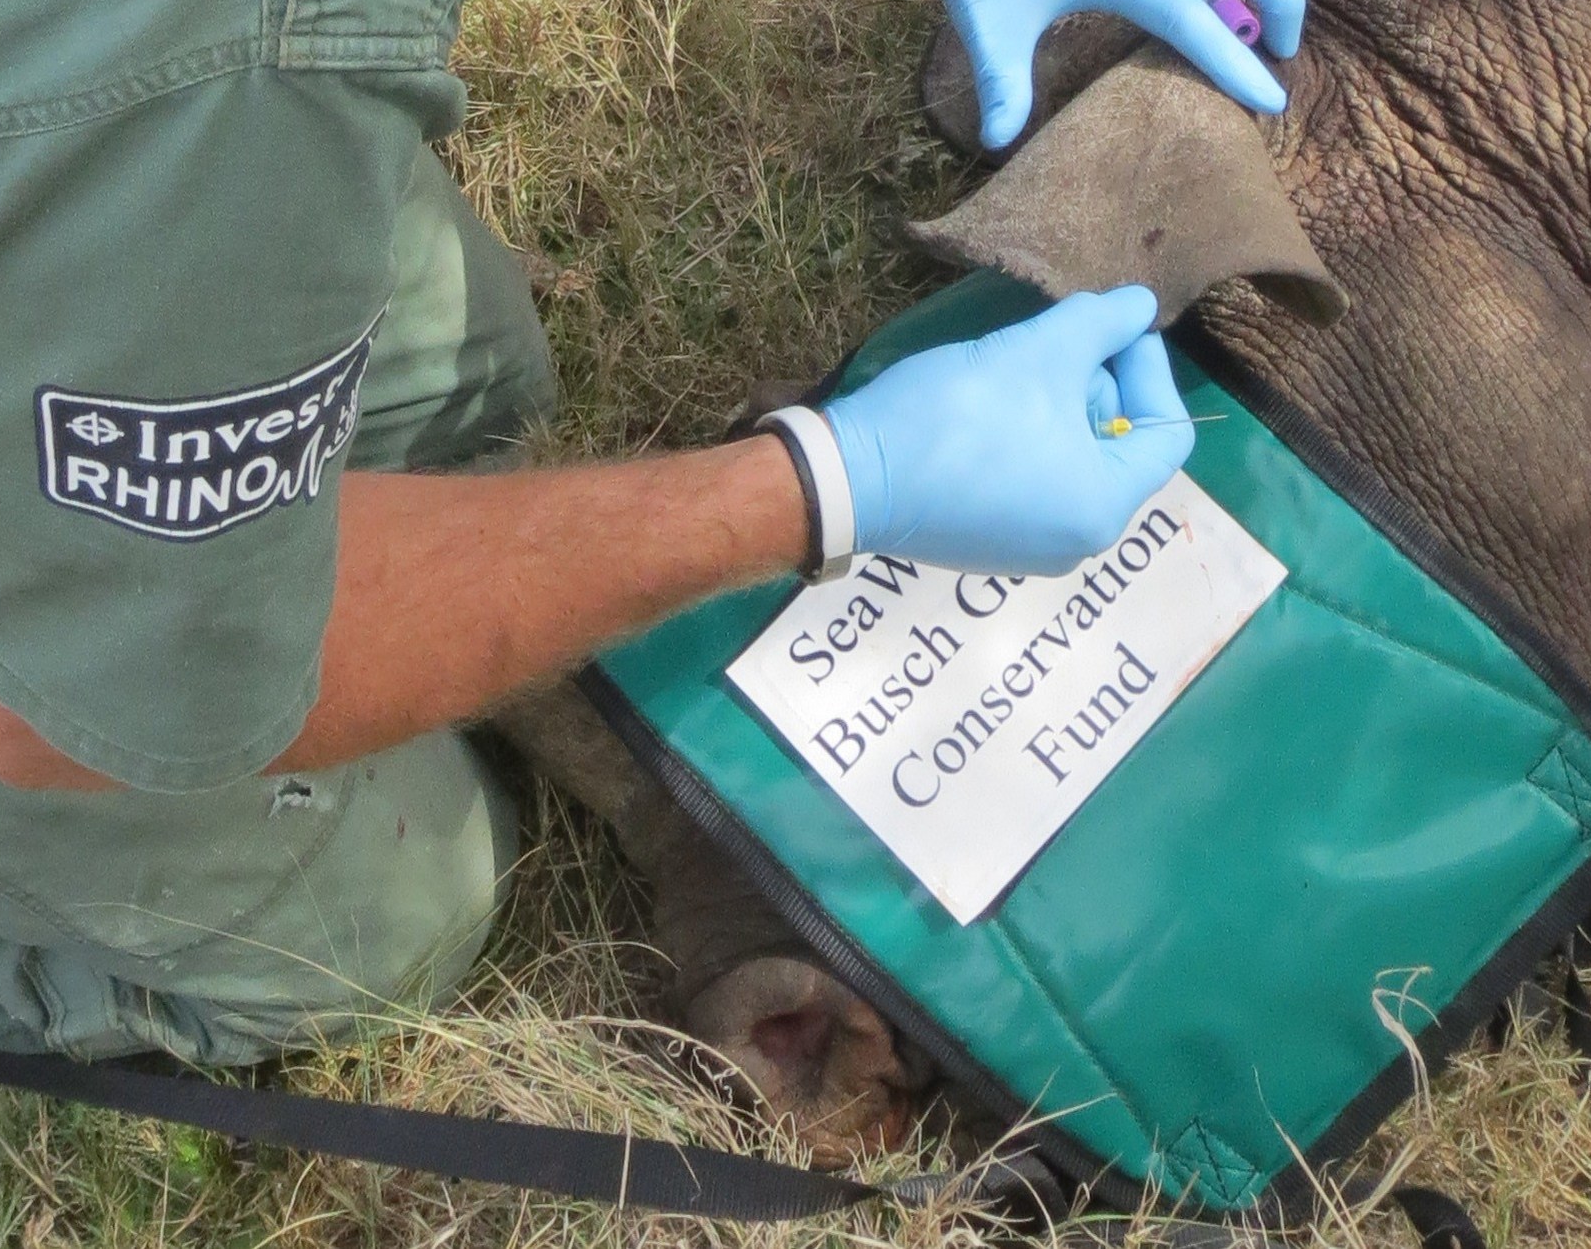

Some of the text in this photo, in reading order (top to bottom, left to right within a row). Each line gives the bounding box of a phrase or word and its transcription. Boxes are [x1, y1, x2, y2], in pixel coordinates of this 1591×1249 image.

[66, 455, 279, 522] RHINO
[789, 554, 920, 687] SeaW
[891, 503, 1182, 808] Conservation
[812, 624, 965, 777] Busch
[1021, 642, 1159, 786] Fund
